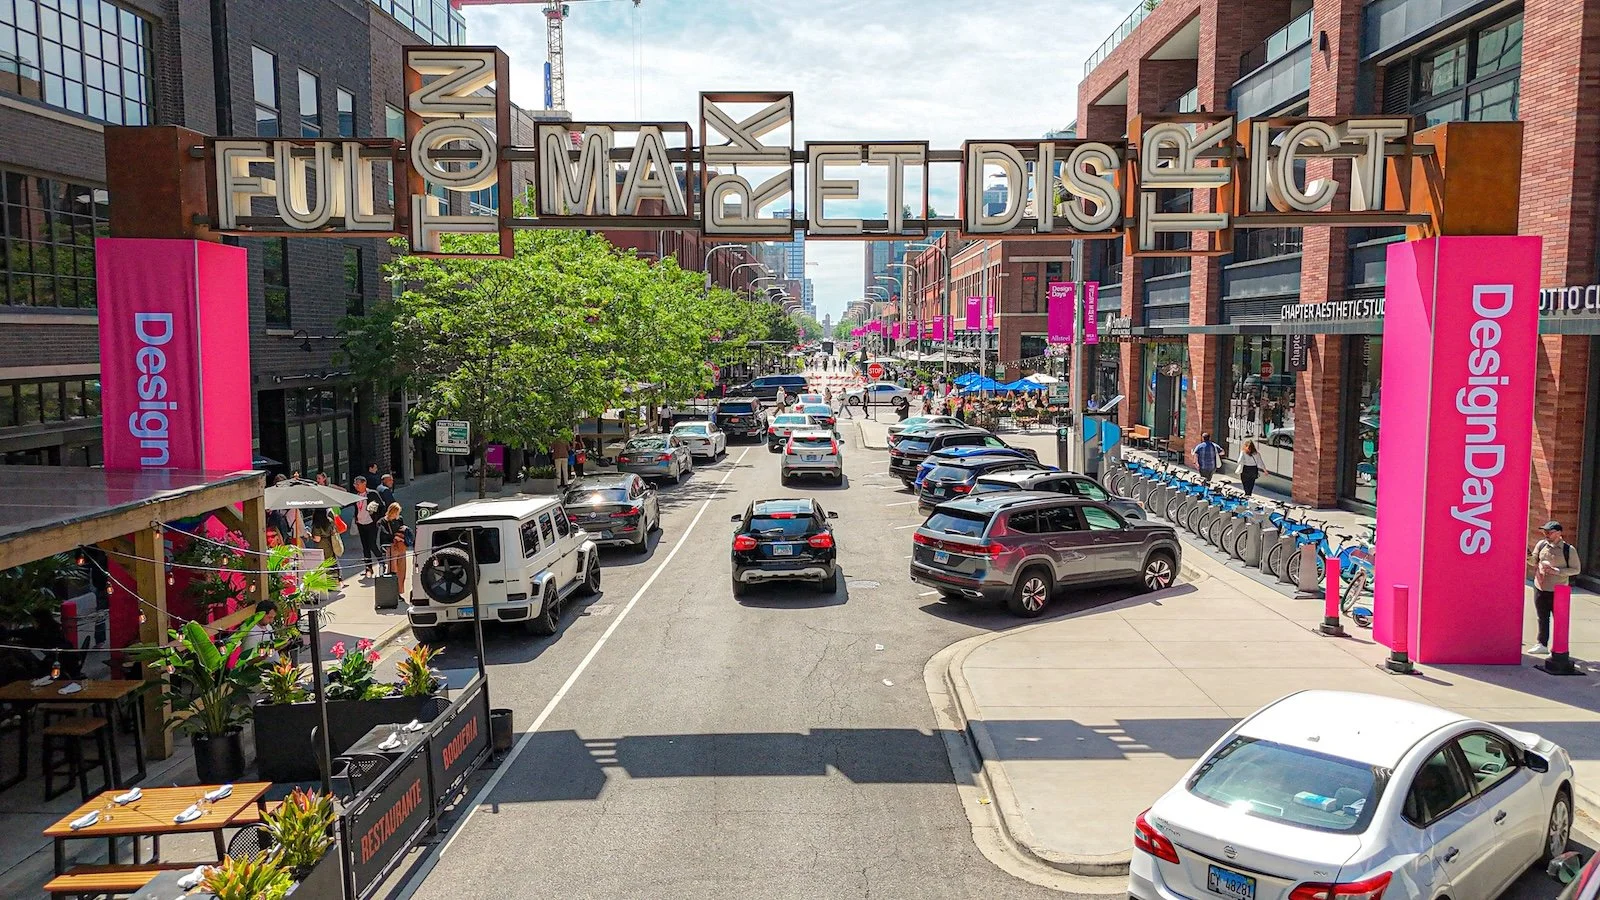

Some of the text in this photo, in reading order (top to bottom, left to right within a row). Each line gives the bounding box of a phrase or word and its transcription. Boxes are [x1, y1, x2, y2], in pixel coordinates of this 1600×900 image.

[1281, 303, 1315, 319] CHAPTER
[1315, 299, 1362, 318] AESTHETIC
[1451, 284, 1514, 555] DesignDays
[442, 715, 478, 771] BOQUERIA
[360, 778, 423, 864] RESTAURANTE
[1225, 878, 1252, 899] 48281
